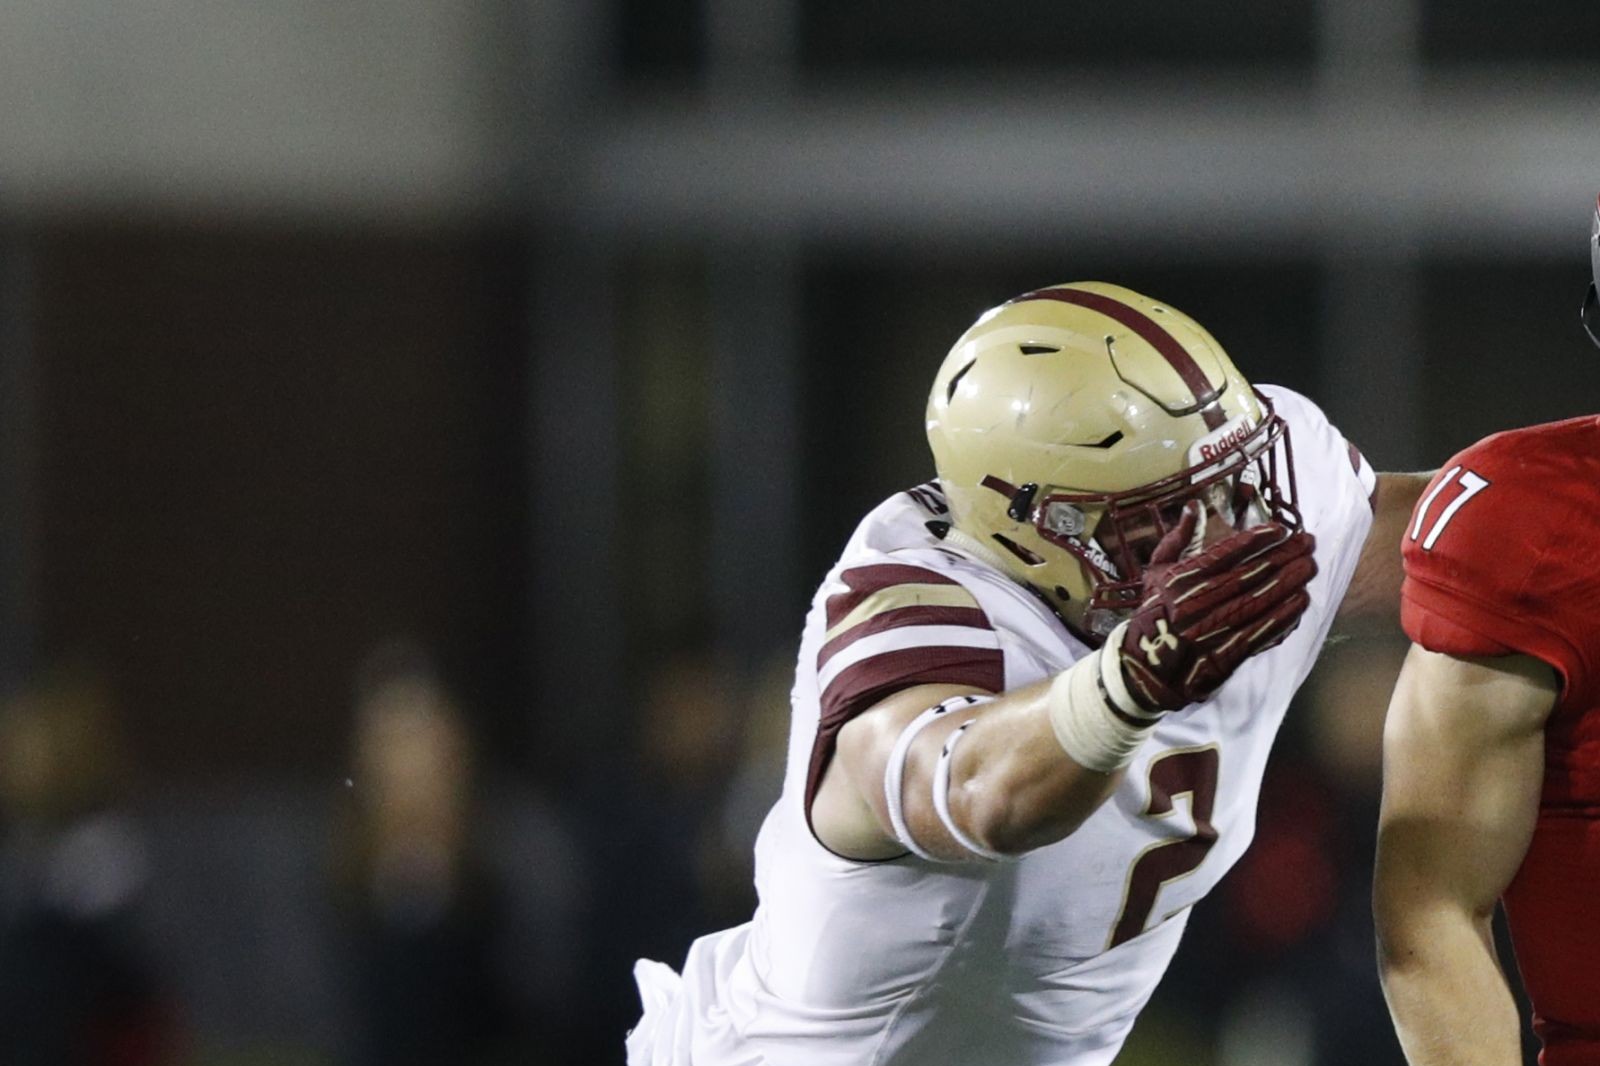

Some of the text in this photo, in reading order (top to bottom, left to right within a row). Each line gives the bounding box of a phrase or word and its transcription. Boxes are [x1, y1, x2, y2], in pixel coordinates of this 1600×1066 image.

[1199, 419, 1252, 461] Riddell
[1410, 464, 1490, 551] 17
[1106, 742, 1220, 950] 2
